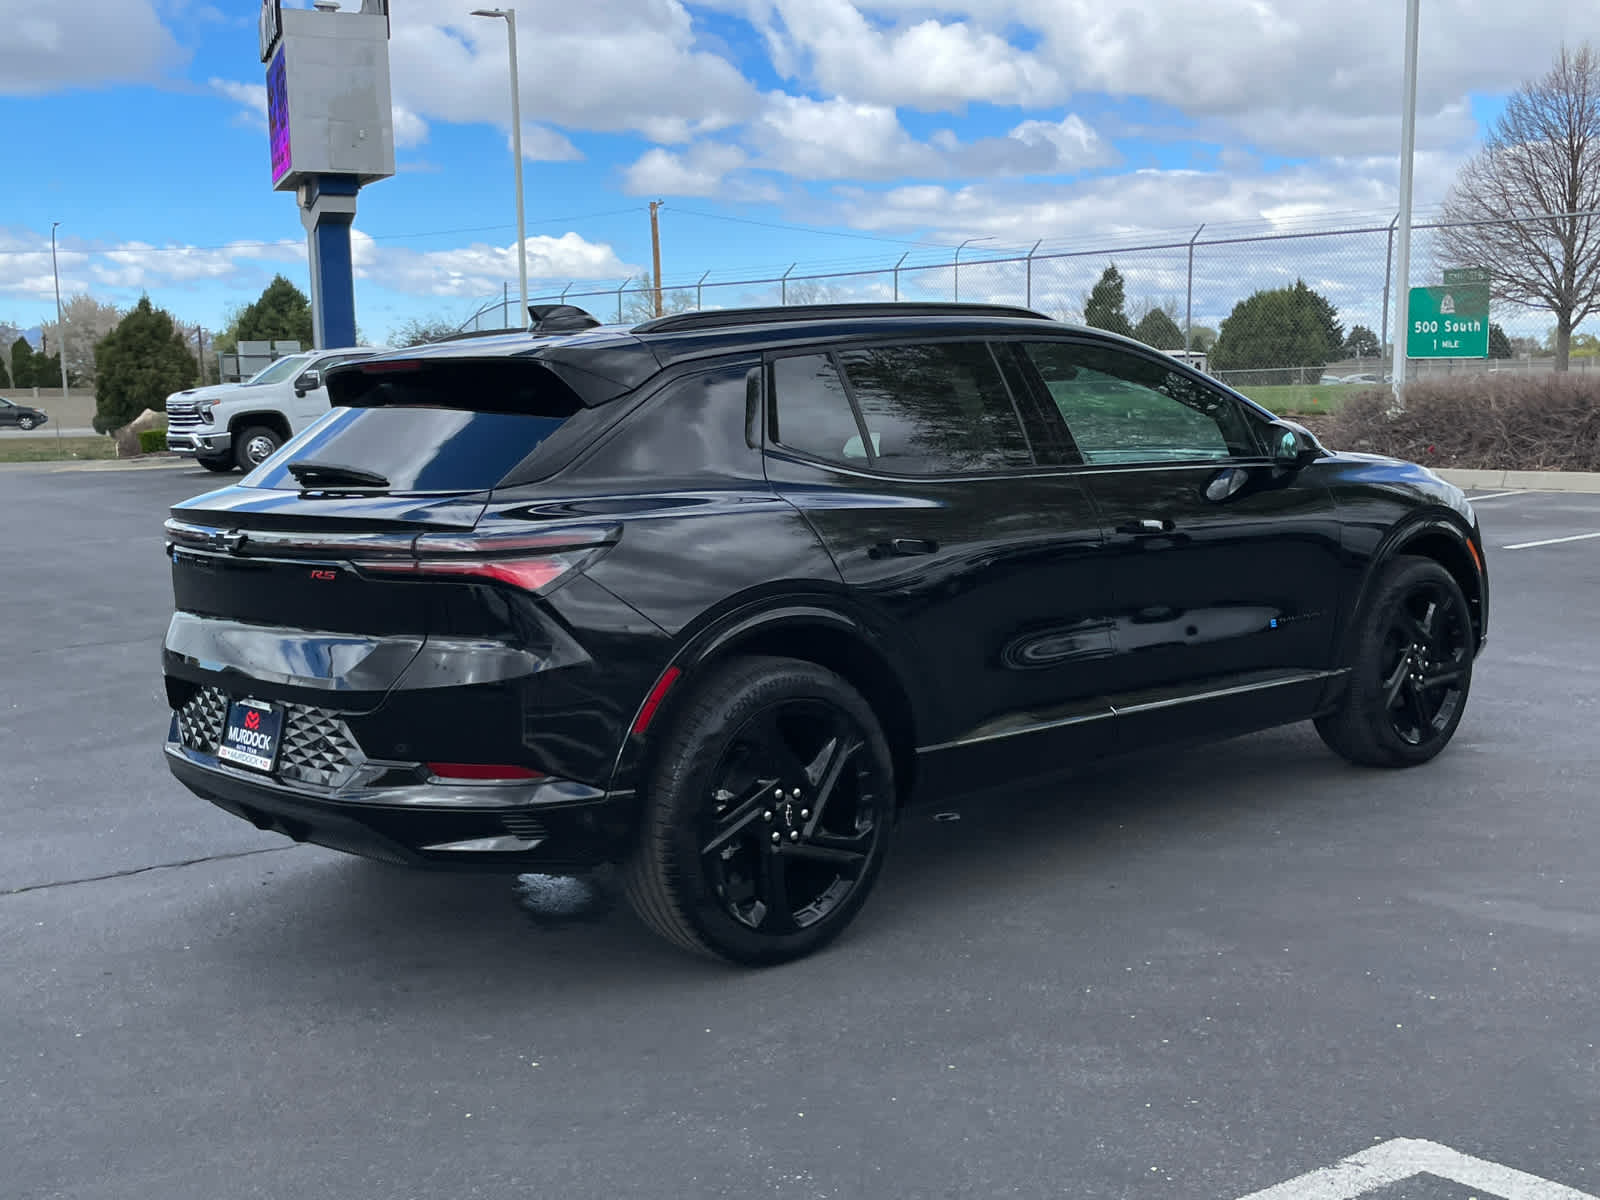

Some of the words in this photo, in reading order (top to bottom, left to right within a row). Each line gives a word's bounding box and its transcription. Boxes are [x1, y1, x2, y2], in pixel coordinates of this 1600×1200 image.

[1414, 320, 1438, 333] 500
[1444, 319, 1481, 333] South
[1433, 339, 1437, 351] 1
[1441, 340, 1460, 349] MILE
[311, 569, 336, 580] RS
[228, 725, 271, 751] MURDOCK
